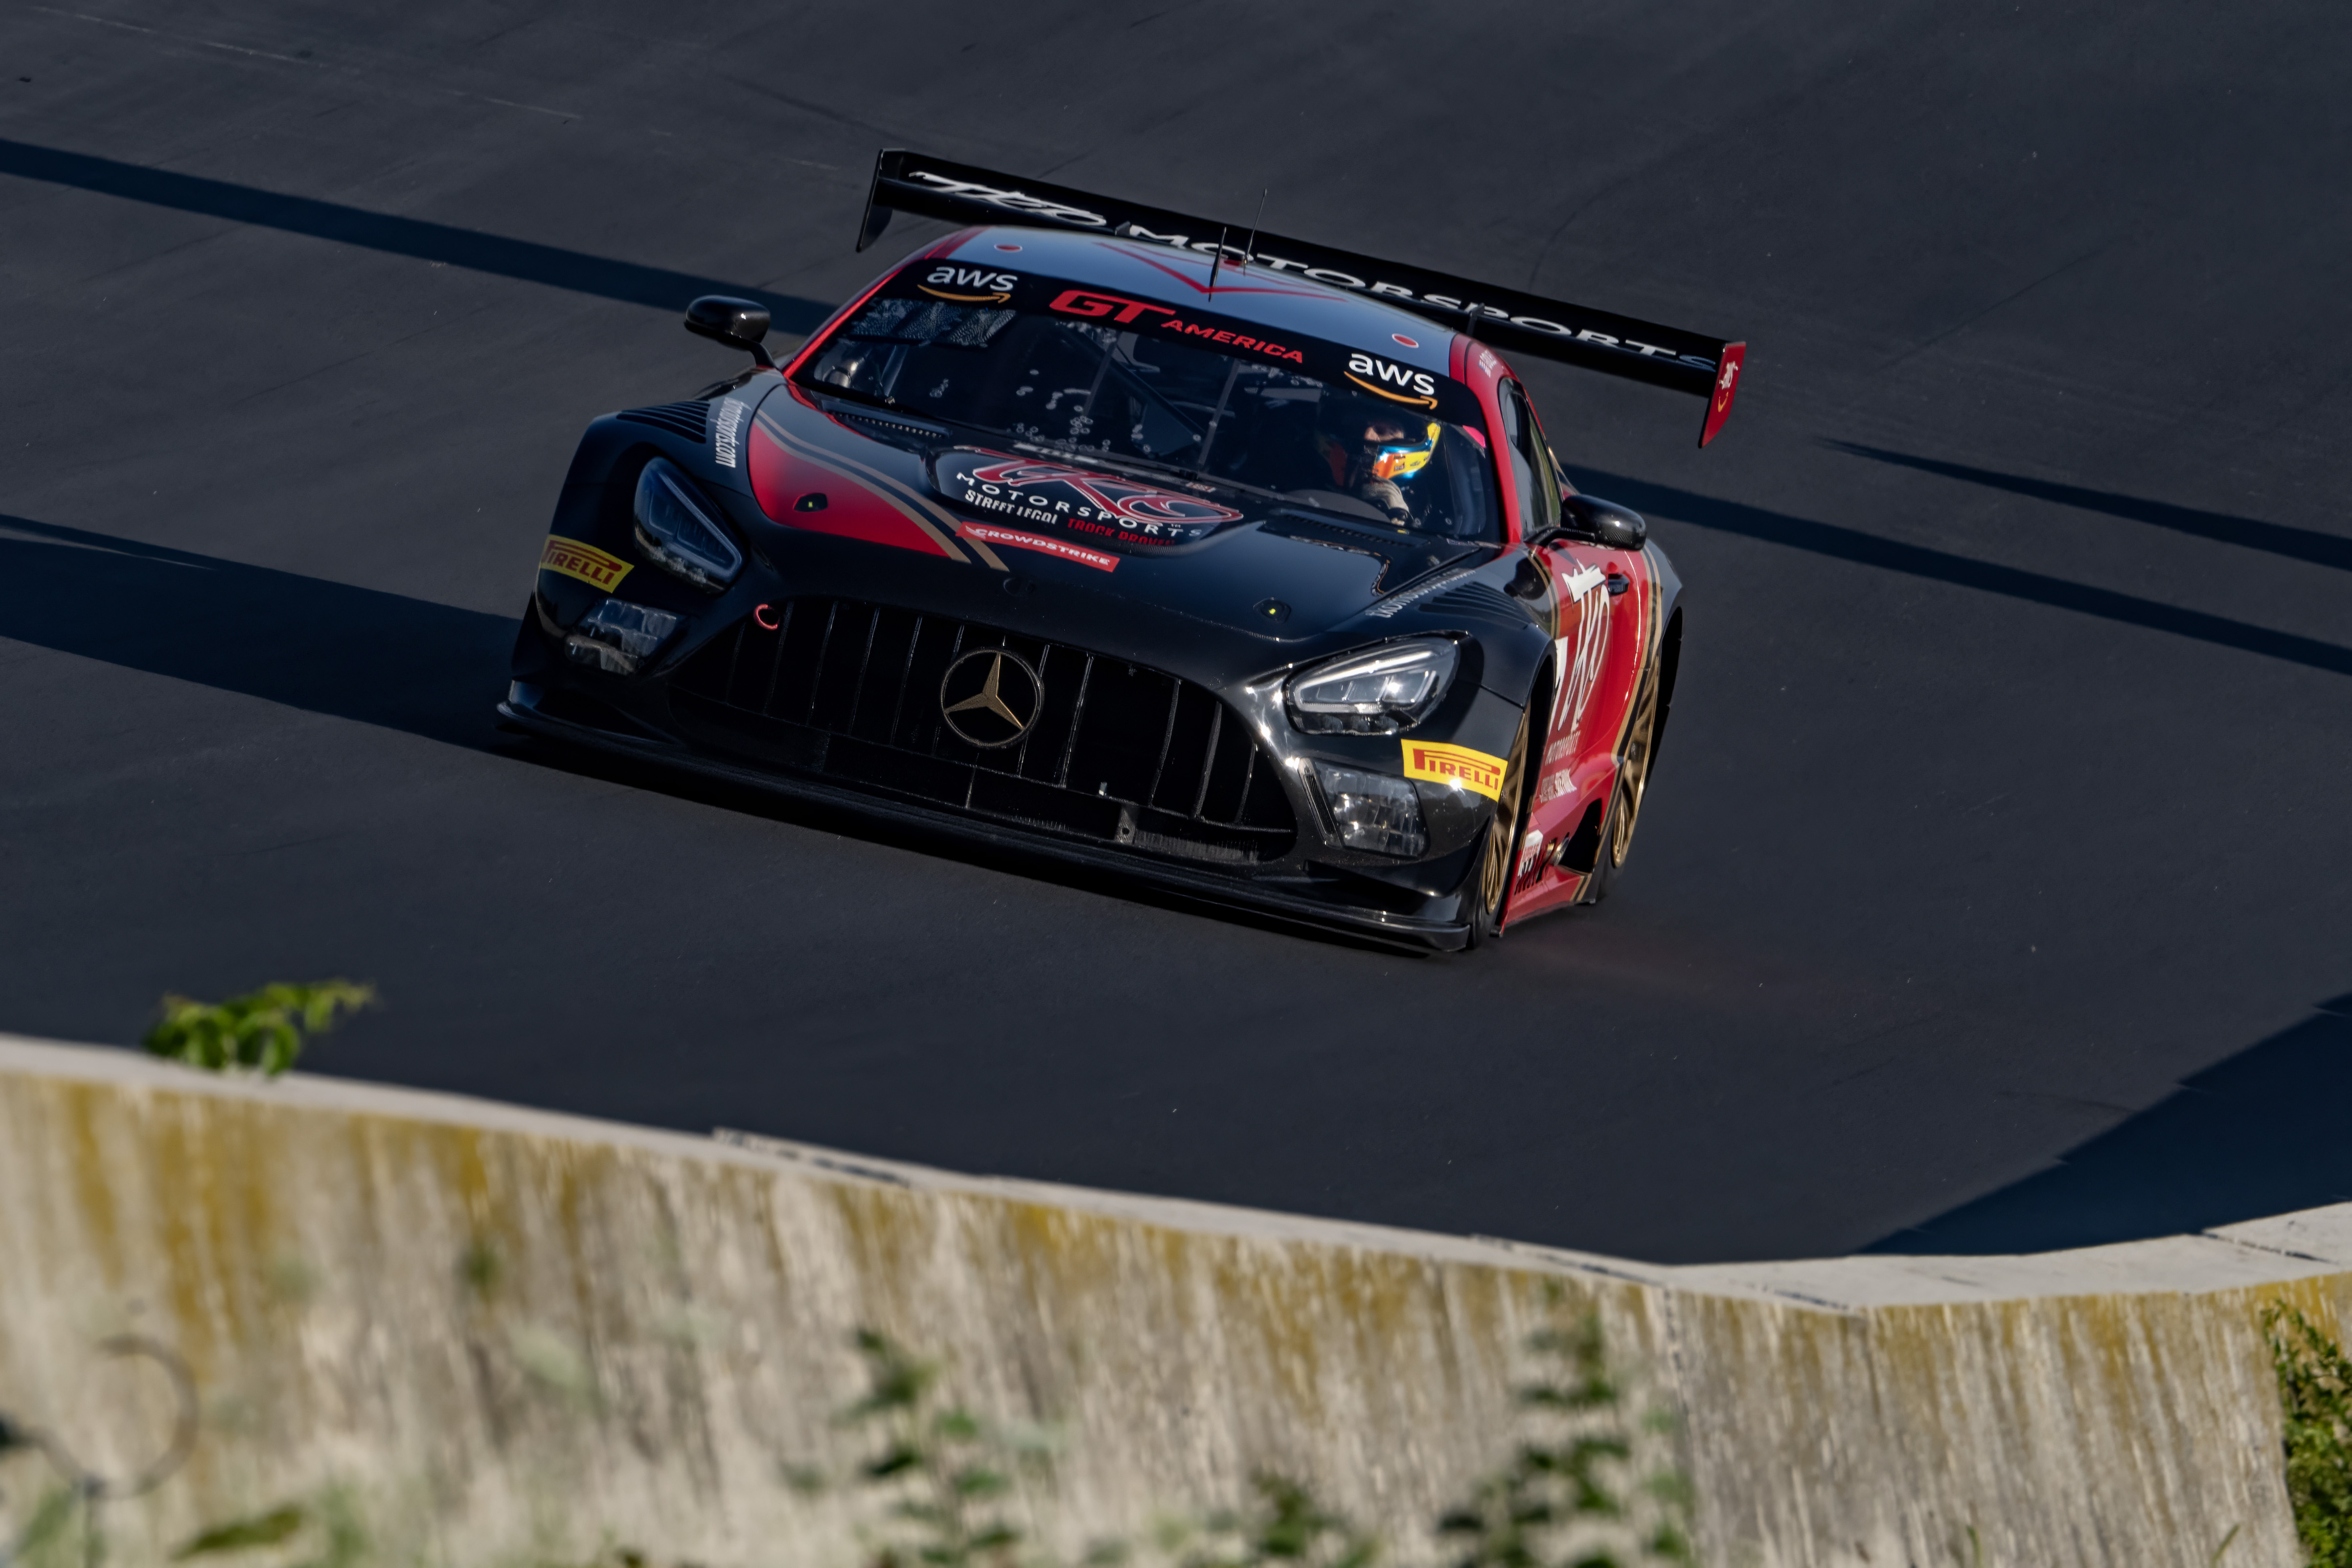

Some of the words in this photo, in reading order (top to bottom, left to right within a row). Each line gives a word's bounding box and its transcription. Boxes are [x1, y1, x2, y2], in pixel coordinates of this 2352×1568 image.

[927, 265, 1018, 292] aws
[1129, 224, 1716, 372] MOTORSPORTS
[1049, 290, 1176, 323] GT
[1161, 319, 1303, 364] AMERICA
[1348, 353, 1435, 396] aws
[956, 472, 1202, 537] MOTORSPORTS
[964, 489, 1015, 514] STREET
[1067, 518, 1115, 537] TRACK
[541, 540, 623, 585] PIRELLI
[975, 527, 1110, 566] CROWDSTRIKE
[1413, 748, 1501, 791] PIRELLI
